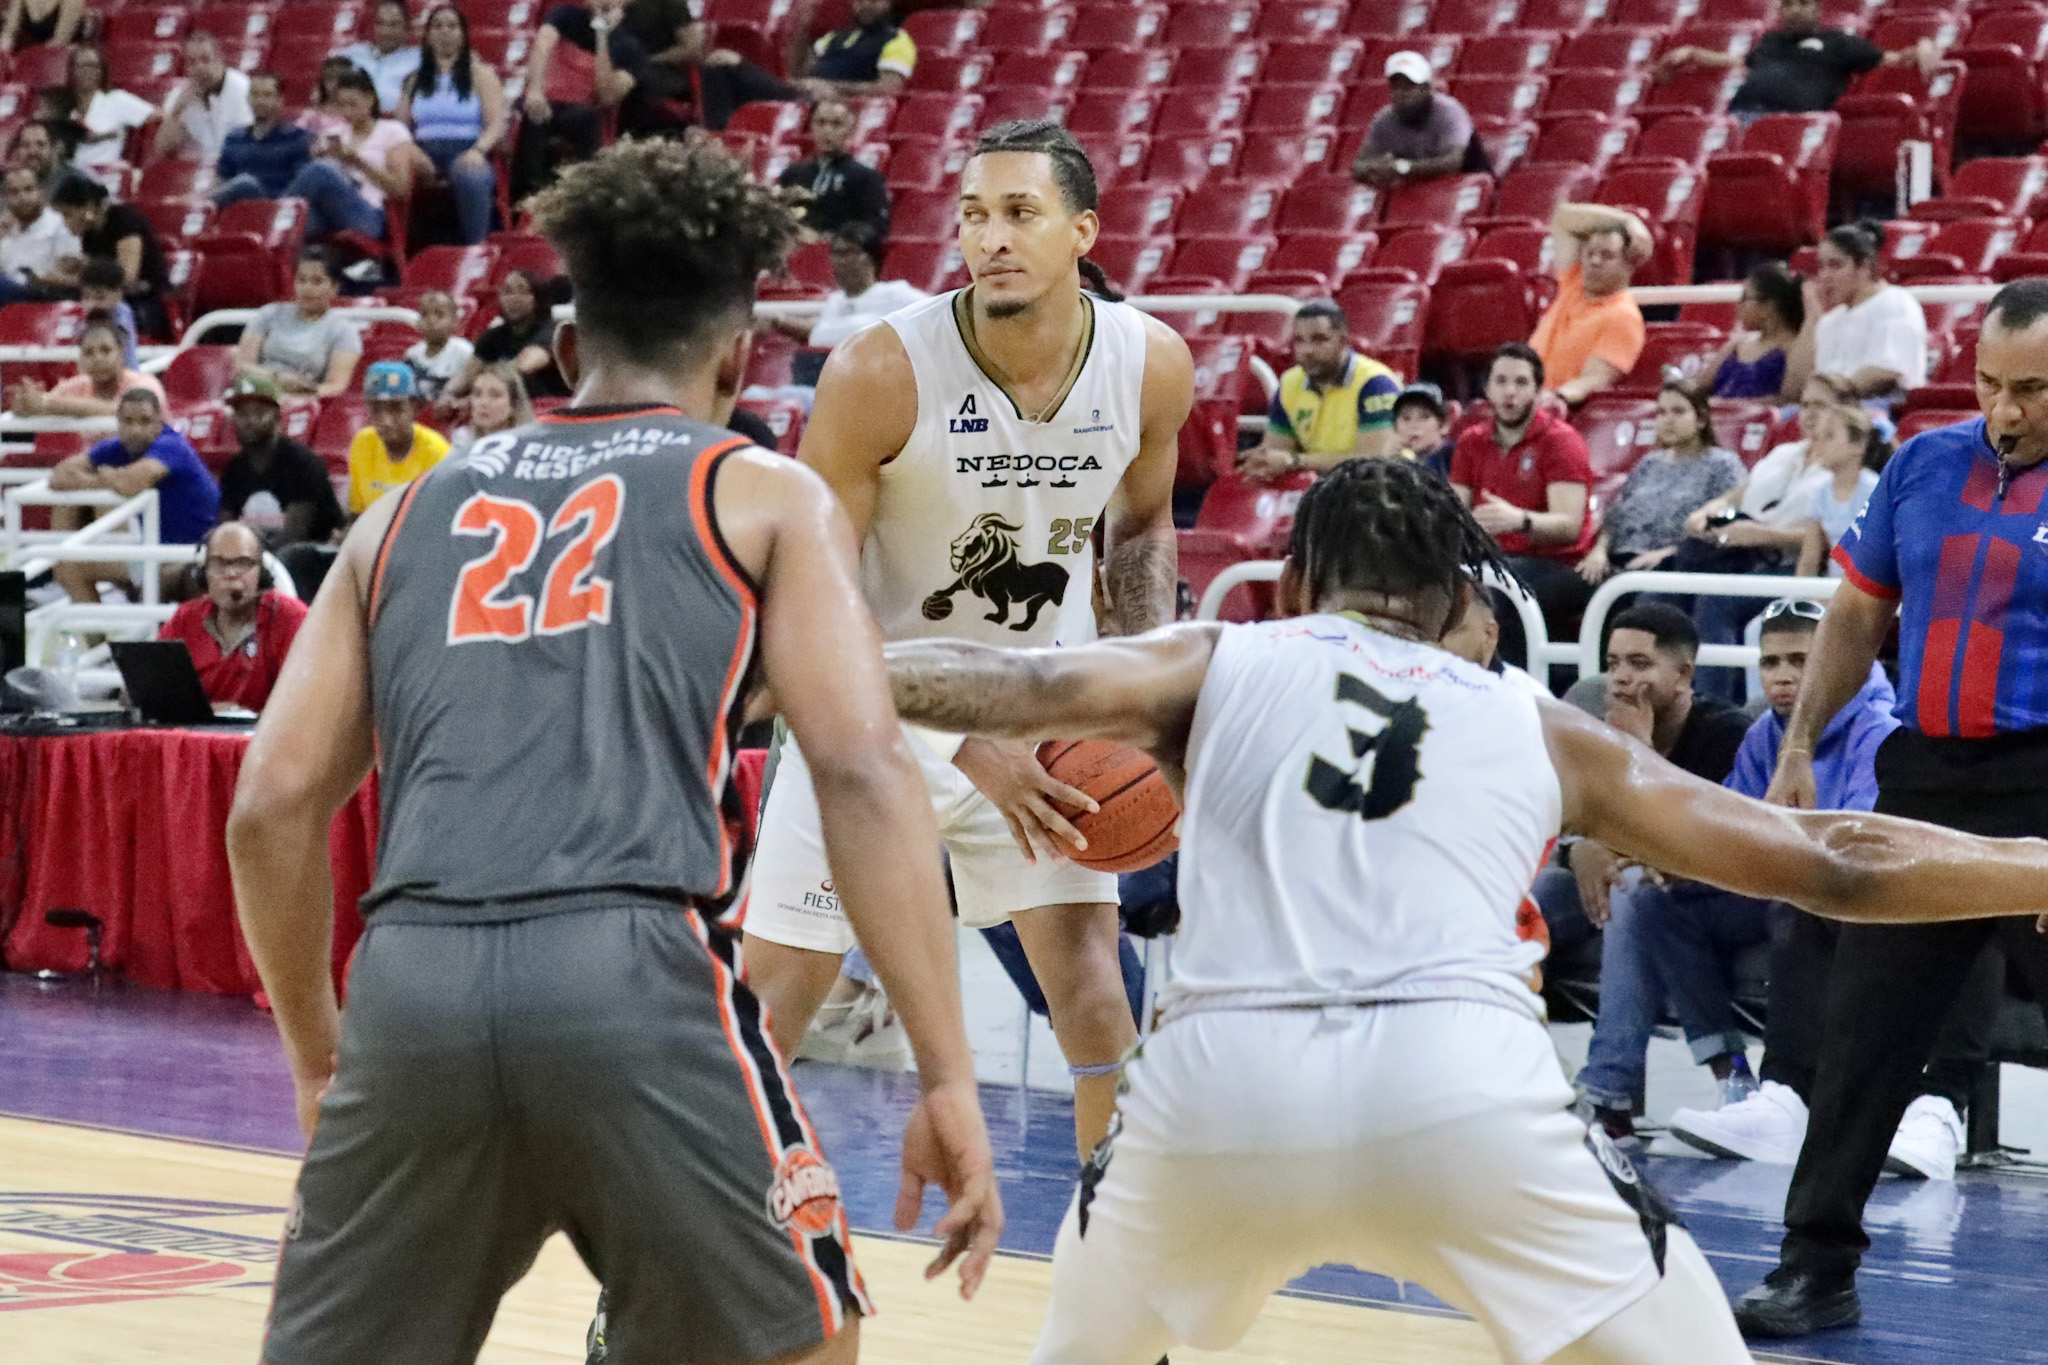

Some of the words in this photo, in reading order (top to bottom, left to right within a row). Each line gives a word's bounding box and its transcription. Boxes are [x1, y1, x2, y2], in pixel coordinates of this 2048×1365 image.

[950, 418, 989, 433] LNB
[956, 454, 1103, 473] NEDOCA
[1048, 518, 1093, 554] 25
[447, 473, 625, 646] 22
[1304, 671, 1433, 822] 3
[803, 892, 842, 911] FIEST
